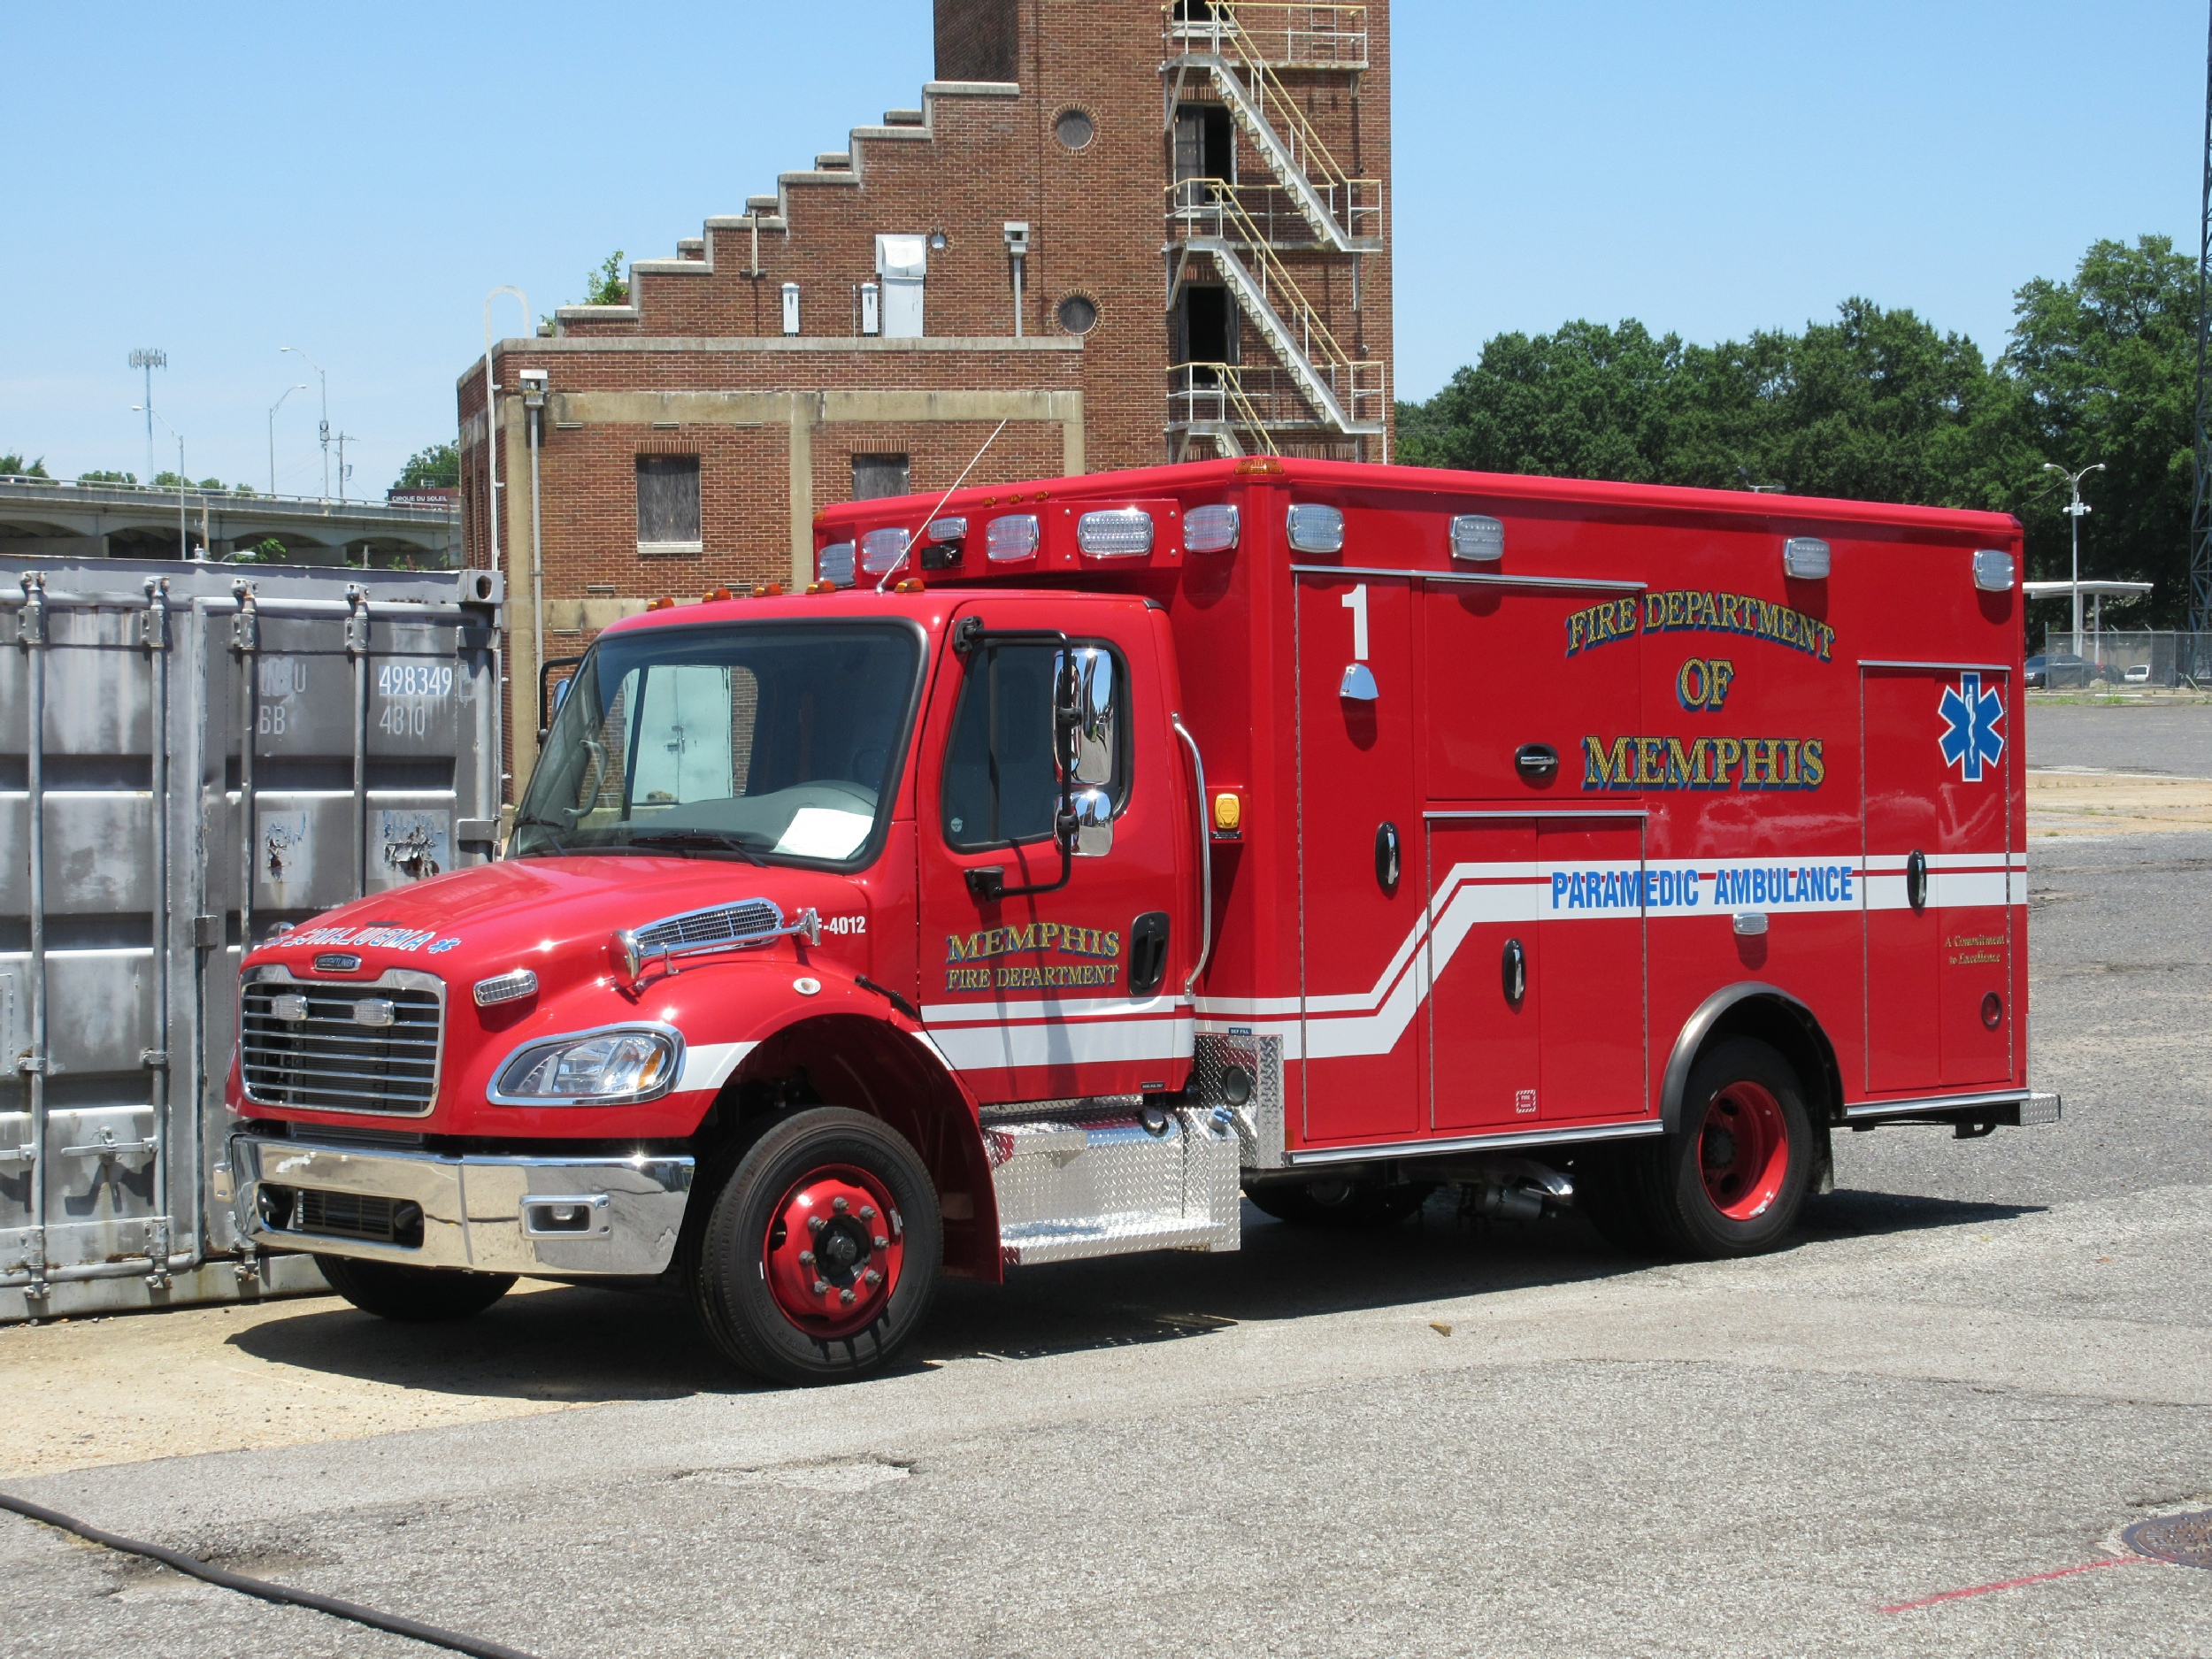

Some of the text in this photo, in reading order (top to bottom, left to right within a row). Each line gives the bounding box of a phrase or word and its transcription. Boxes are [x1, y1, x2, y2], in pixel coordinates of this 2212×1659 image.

[1341, 583, 1369, 660] 1
[1565, 589, 1835, 664] FIRE DEPARTMENT
[379, 666, 452, 695] 498349
[1676, 657, 1734, 711] OF
[1581, 735, 1825, 791] MEMPHIS
[1552, 866, 1853, 909] PARAMEDIC AMBULANCE
[946, 922, 1120, 964] MEMPHIS
[946, 964, 1119, 992] FIRE DEPARTMENT
